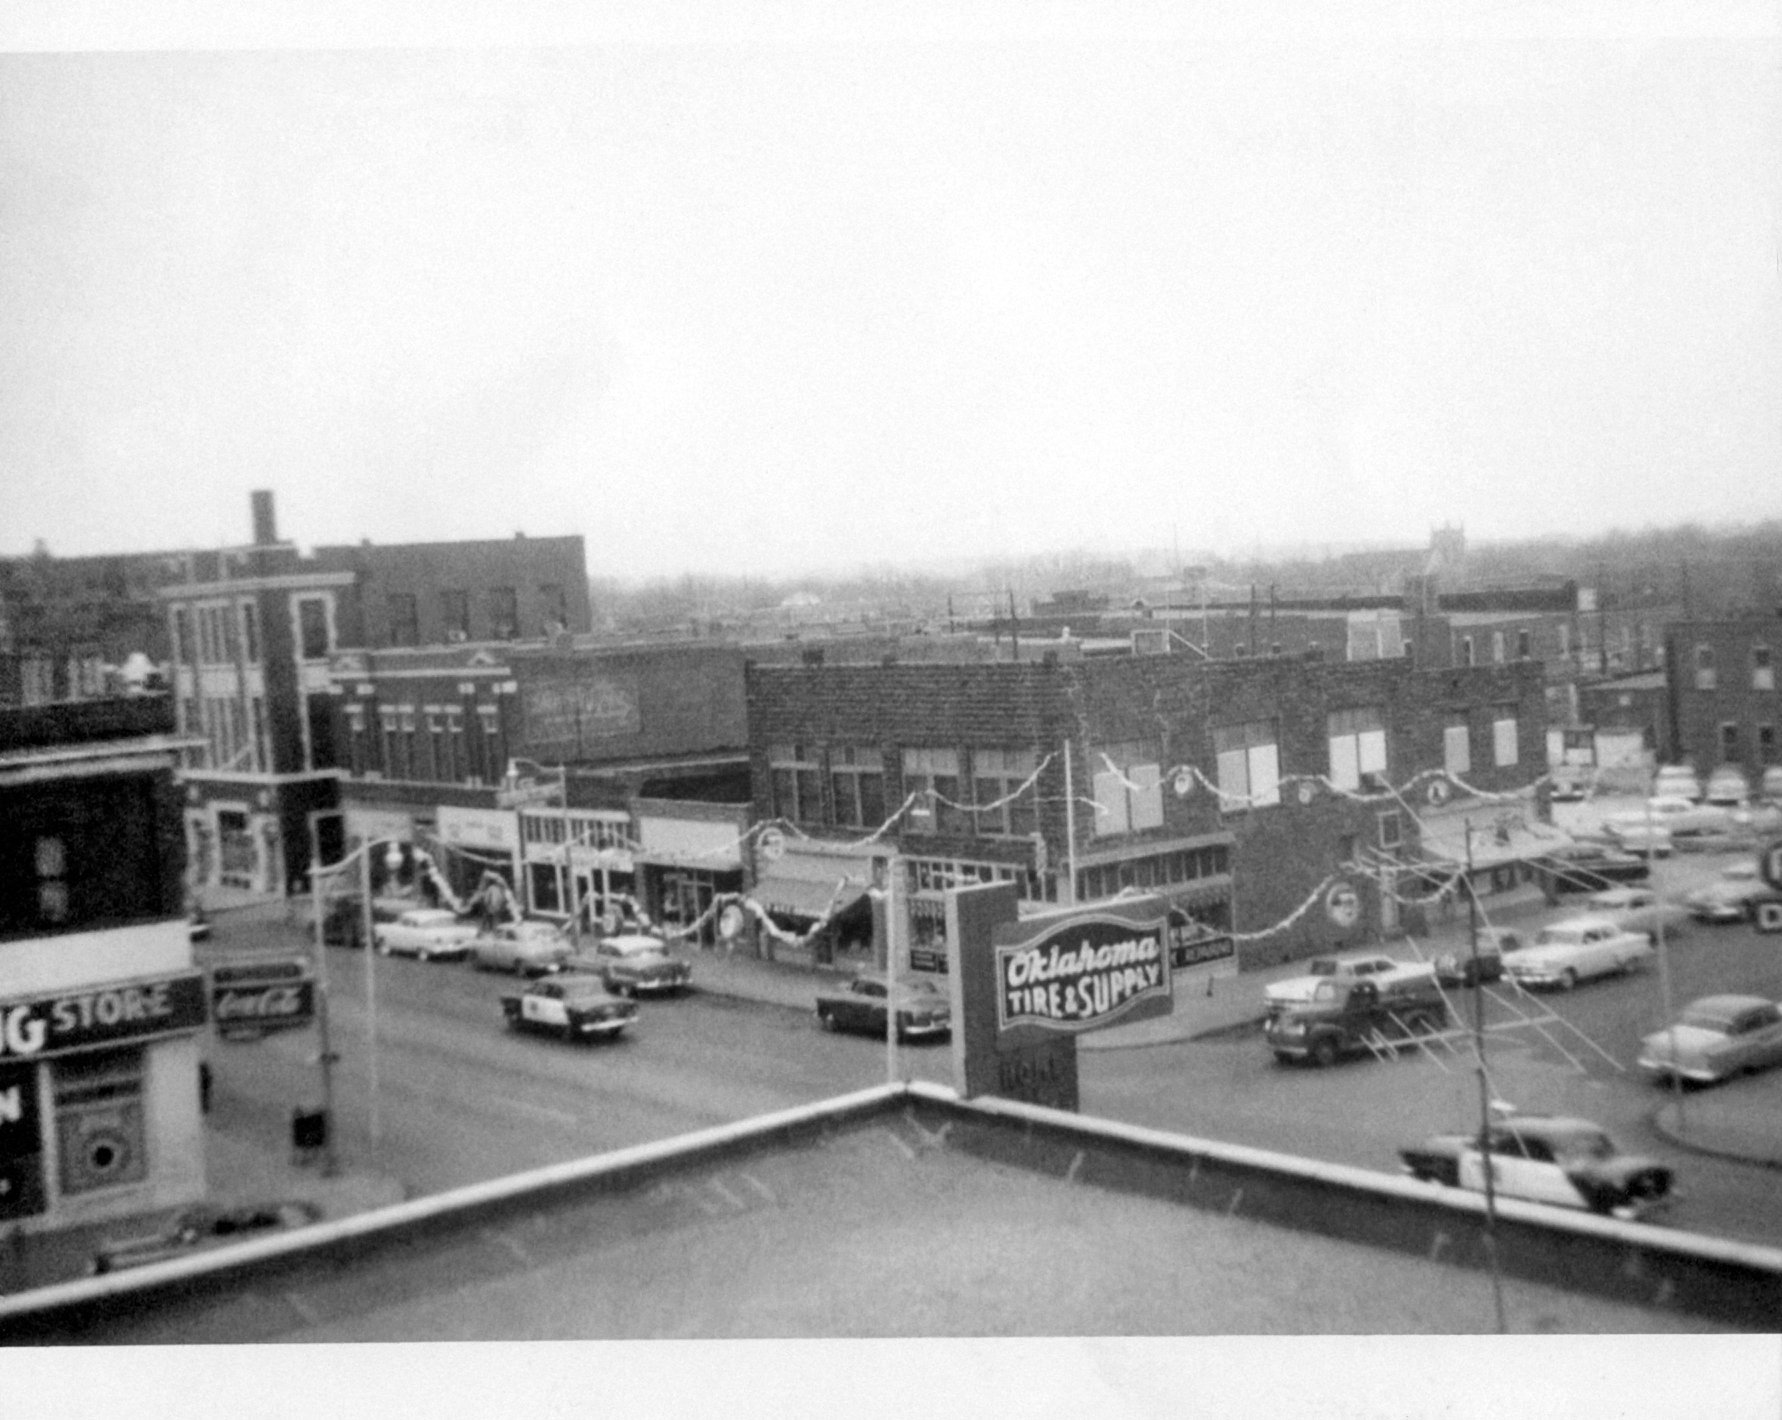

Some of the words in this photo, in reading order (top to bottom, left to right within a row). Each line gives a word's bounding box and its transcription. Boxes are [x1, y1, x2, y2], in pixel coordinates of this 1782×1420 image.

[1008, 936, 1158, 987] Oklahoma
[53, 983, 173, 1032] STORE
[1008, 982, 1063, 1018] TIRE
[1079, 963, 1161, 1018] SUPPLY
